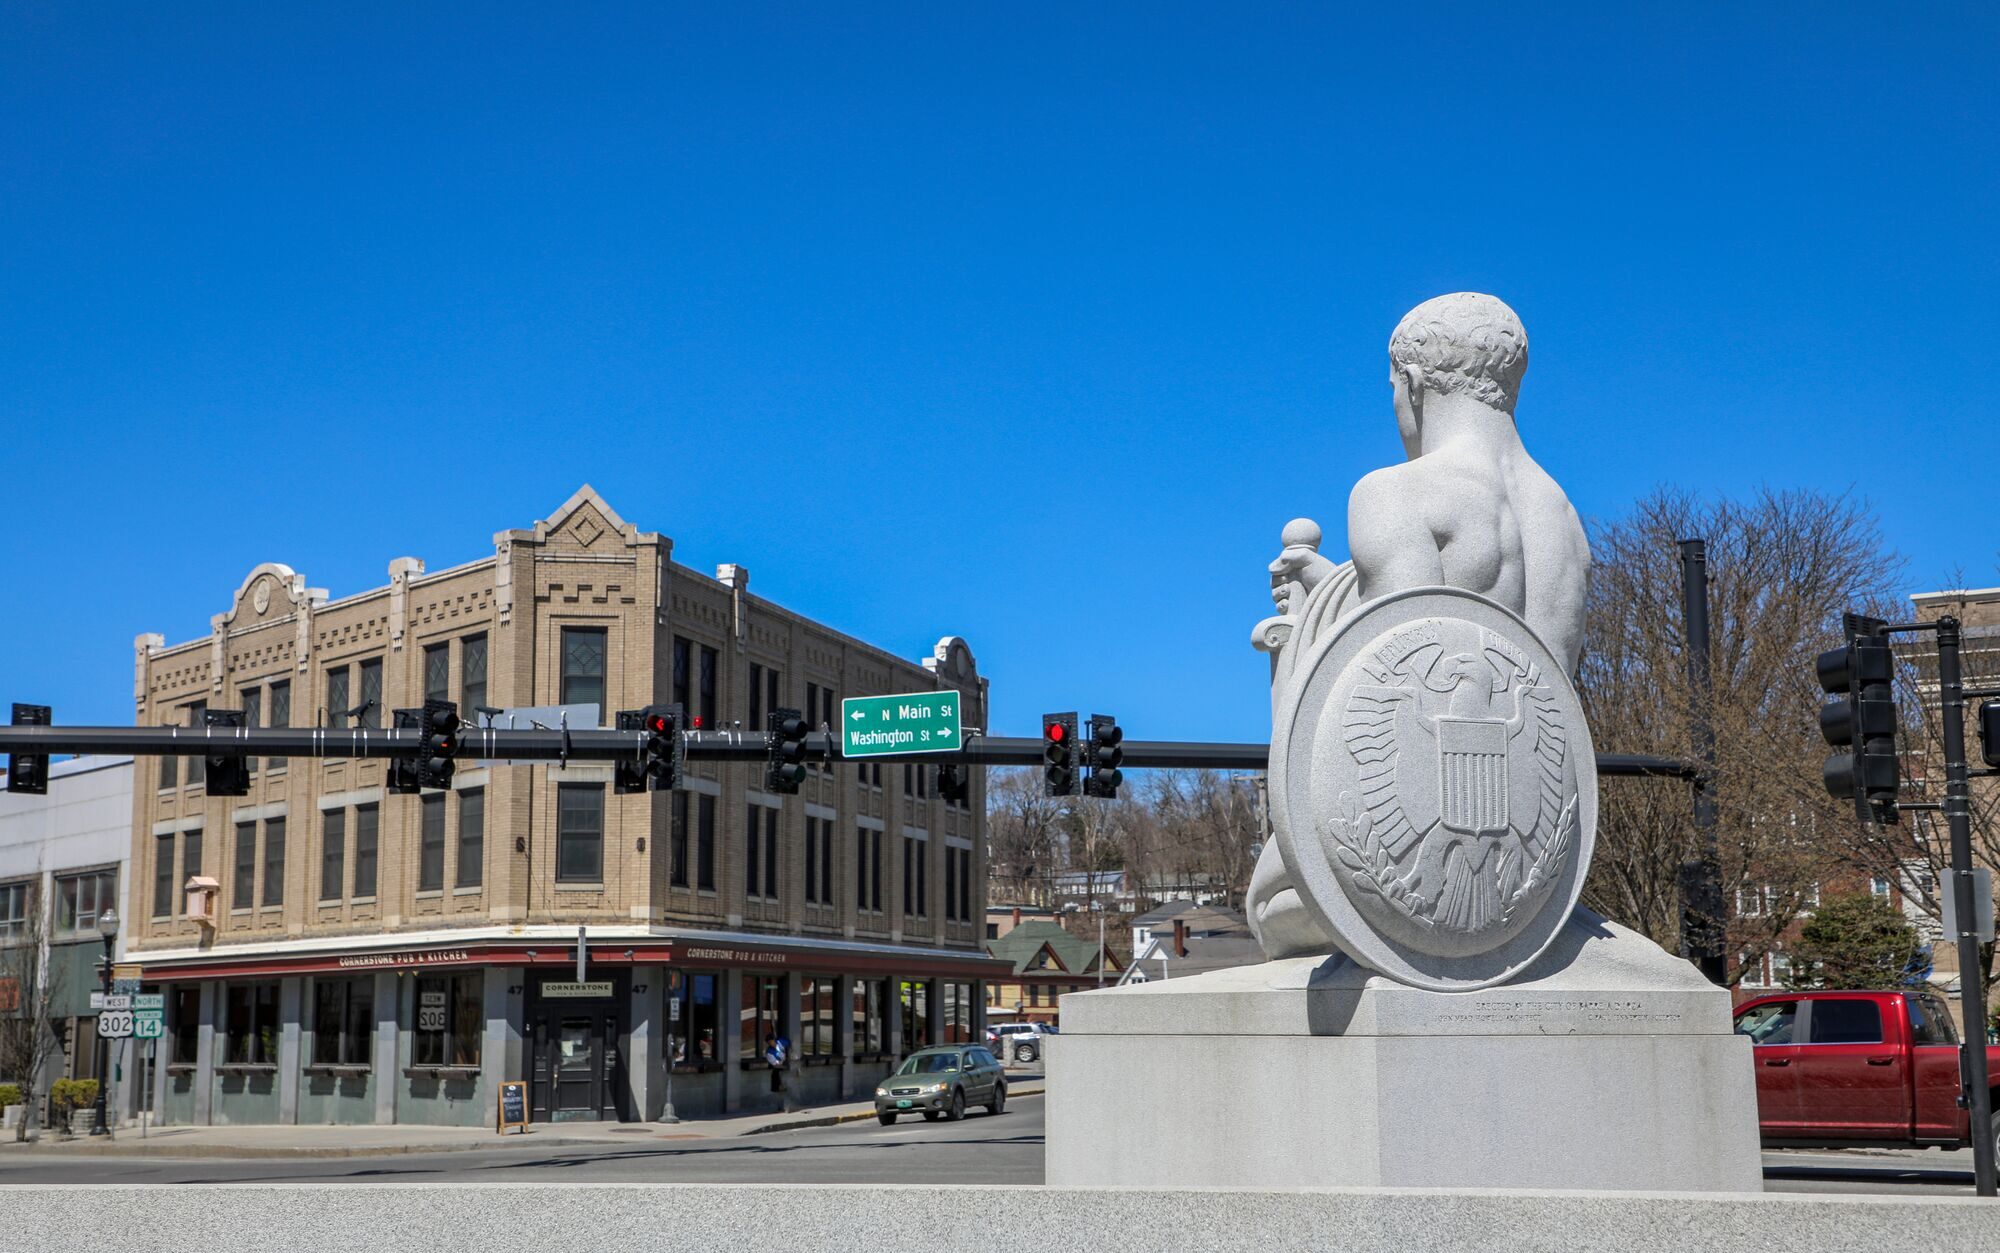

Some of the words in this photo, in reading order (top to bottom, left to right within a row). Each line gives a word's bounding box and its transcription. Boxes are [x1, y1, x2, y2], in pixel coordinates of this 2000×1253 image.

[882, 709, 890, 721] N
[899, 704, 931, 720] Main
[941, 705, 952, 717] St
[850, 729, 914, 748] Washington
[920, 730, 930, 741] St
[339, 954, 394, 967] CORNERSTONE
[397, 953, 415, 964] PUB
[418, 952, 424, 963] &
[427, 950, 468, 962] KITCHEN
[687, 948, 734, 960] CORNERSTONE
[735, 951, 749, 961] PUB
[758, 952, 786, 963] KITCHEN
[508, 985, 524, 995] 47
[632, 984, 648, 994] 47
[106, 998, 126, 1007] WEST
[136, 996, 161, 1007] NORTH
[101, 1016, 131, 1033] 302
[140, 1020, 156, 1035] 14
